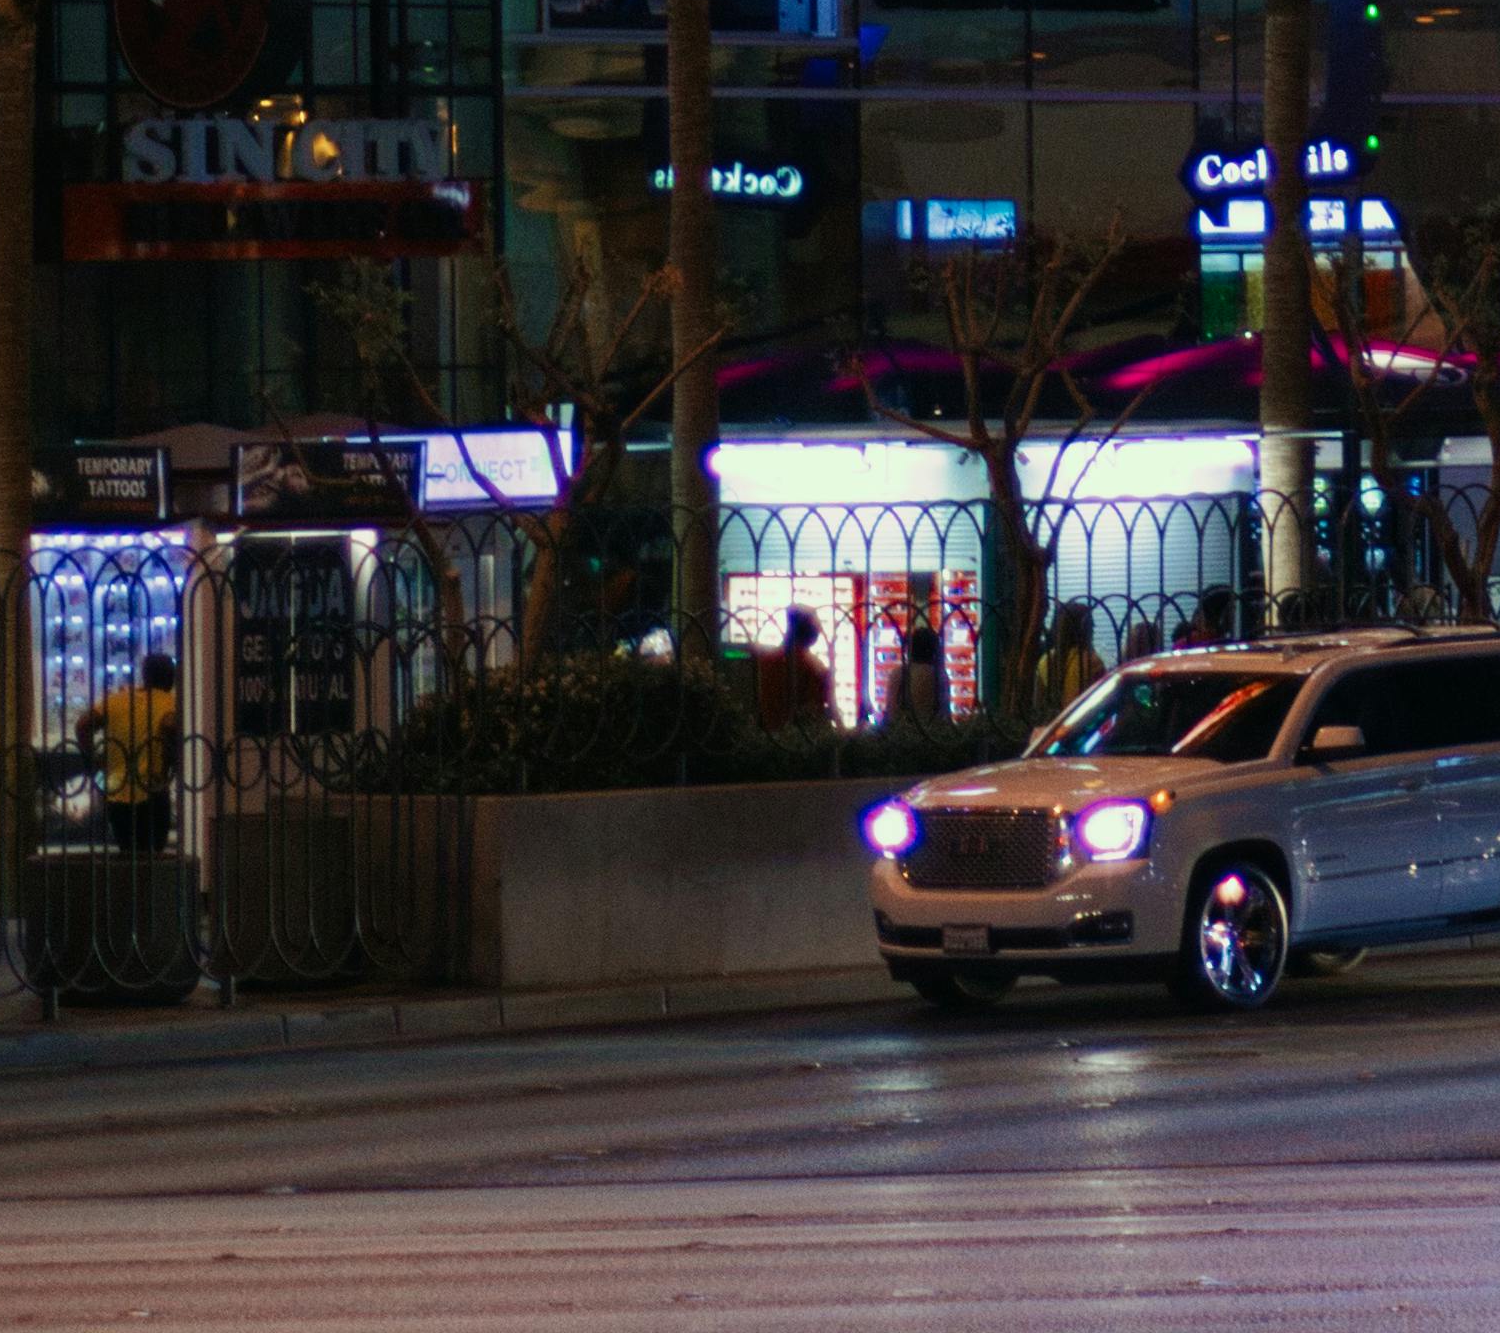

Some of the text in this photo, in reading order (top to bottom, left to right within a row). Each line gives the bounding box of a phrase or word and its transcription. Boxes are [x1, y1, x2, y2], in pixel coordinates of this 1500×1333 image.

[123, 117, 450, 184] SIN CITY
[1197, 140, 1349, 188] Cocils
[76, 457, 154, 476] TEMPORARY
[87, 478, 148, 498] TATTOOS
